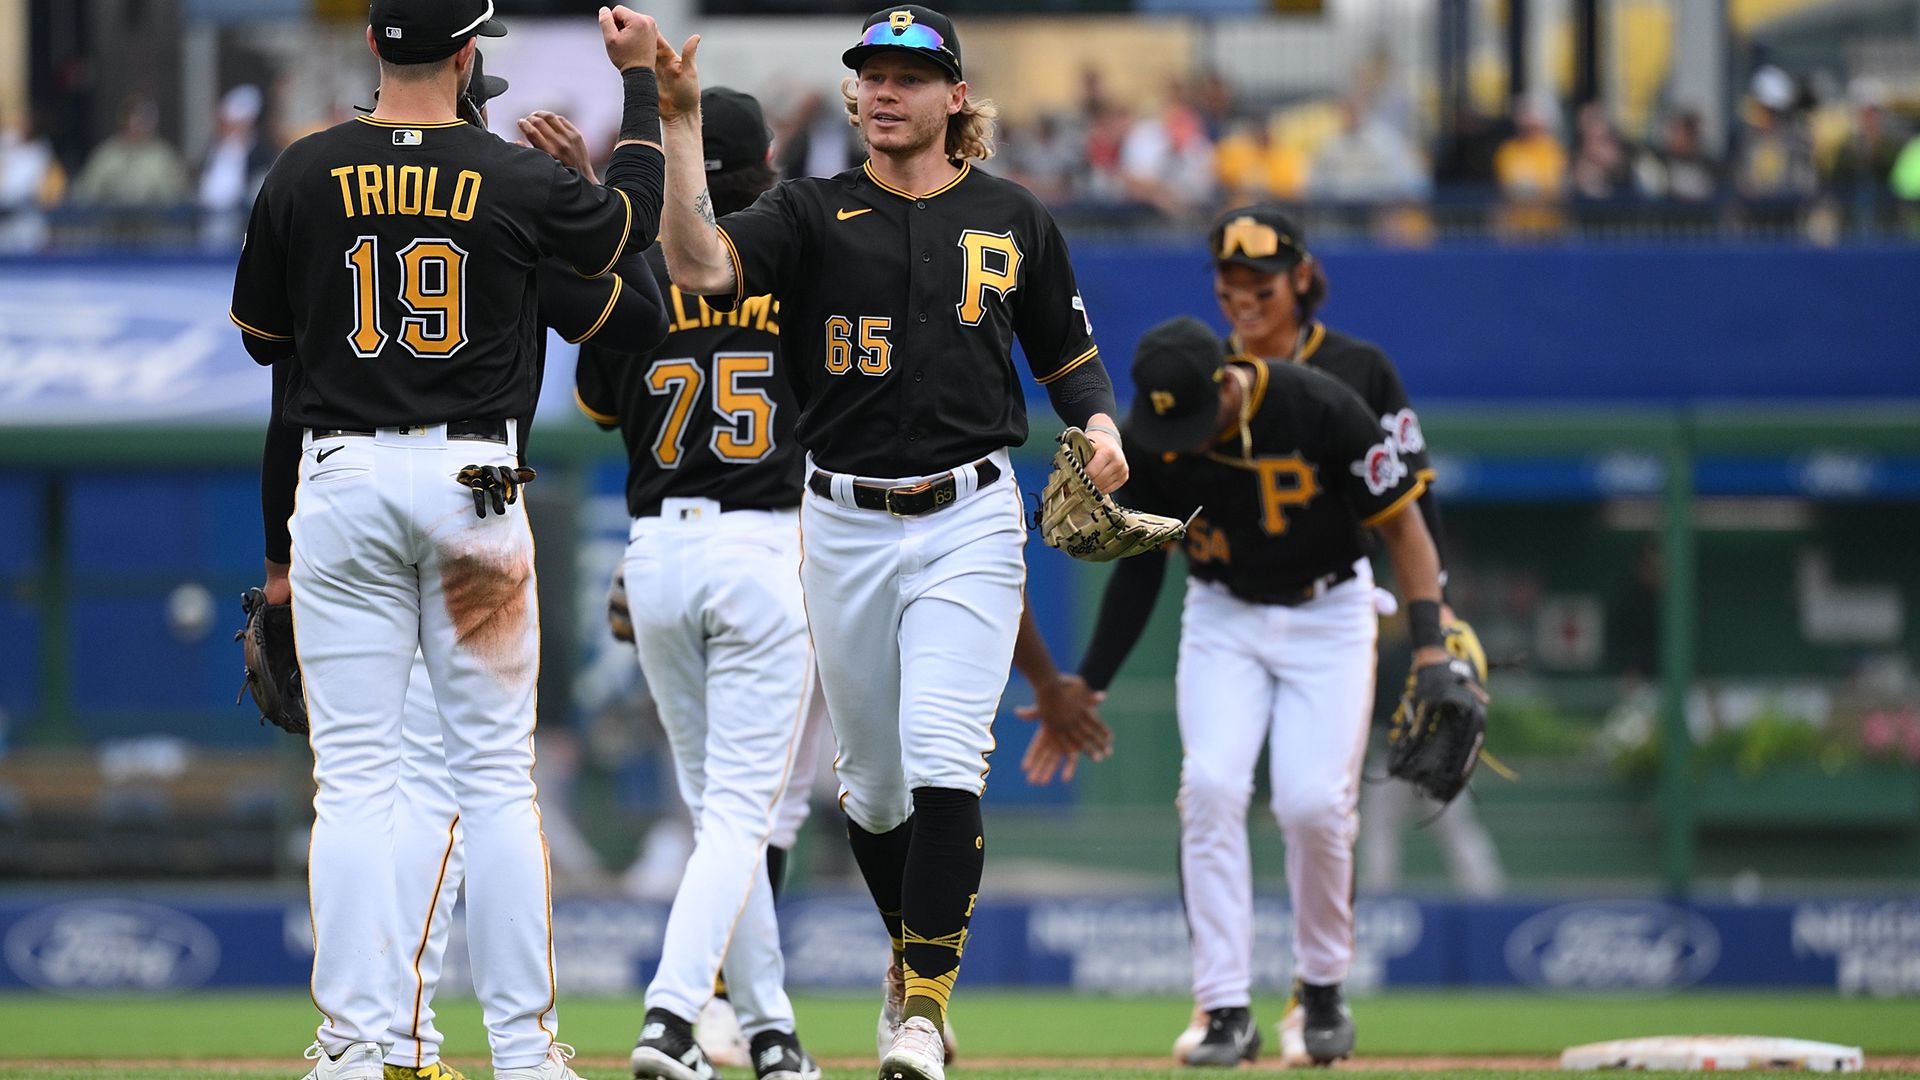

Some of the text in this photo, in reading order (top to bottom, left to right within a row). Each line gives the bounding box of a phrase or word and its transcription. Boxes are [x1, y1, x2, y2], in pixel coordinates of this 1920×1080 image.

[331, 164, 482, 221] TRIOLO
[345, 235, 469, 358] 19
[956, 229, 1024, 327] P
[825, 315, 893, 377] 65
[644, 351, 777, 470] 75
[935, 490, 952, 505] 65
[1258, 451, 1323, 535] P
